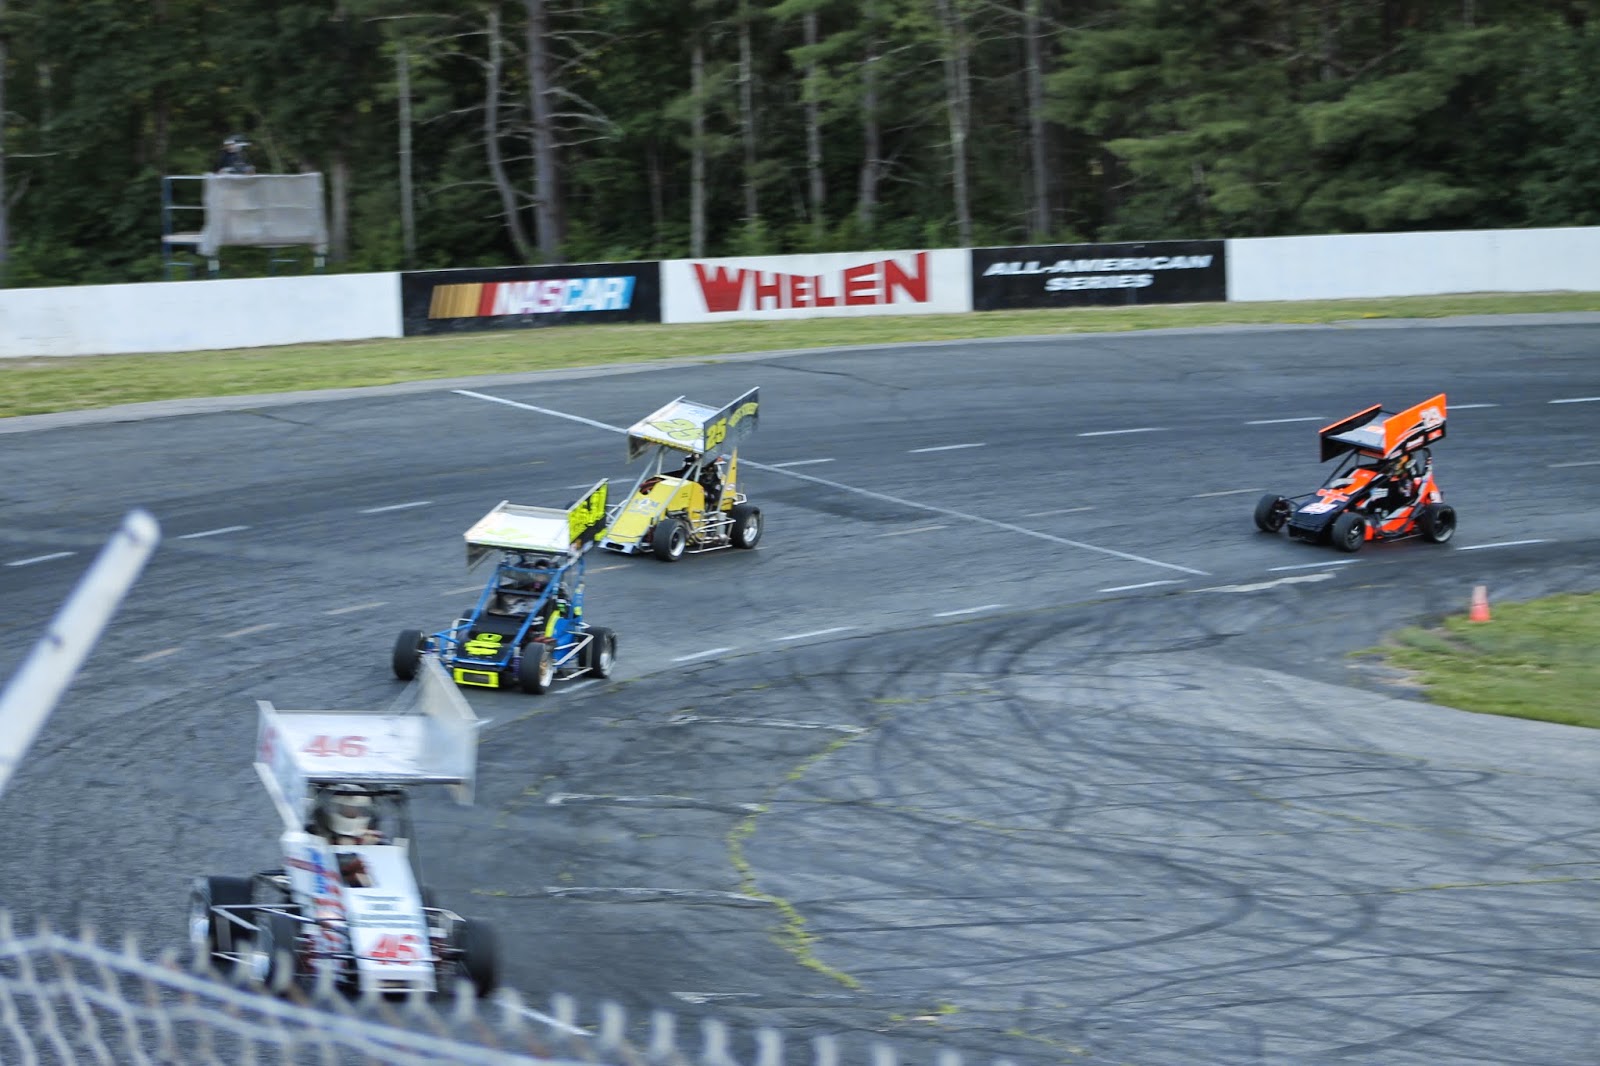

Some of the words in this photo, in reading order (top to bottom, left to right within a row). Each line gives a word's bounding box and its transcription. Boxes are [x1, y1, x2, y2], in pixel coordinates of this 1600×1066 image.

[982, 254, 1214, 277] ALL-AMERICAN
[693, 251, 929, 313] WHELEN
[1043, 273, 1154, 292] SERIES
[491, 276, 632, 317] NASCAR
[705, 417, 727, 451] 25
[304, 735, 368, 758] 46
